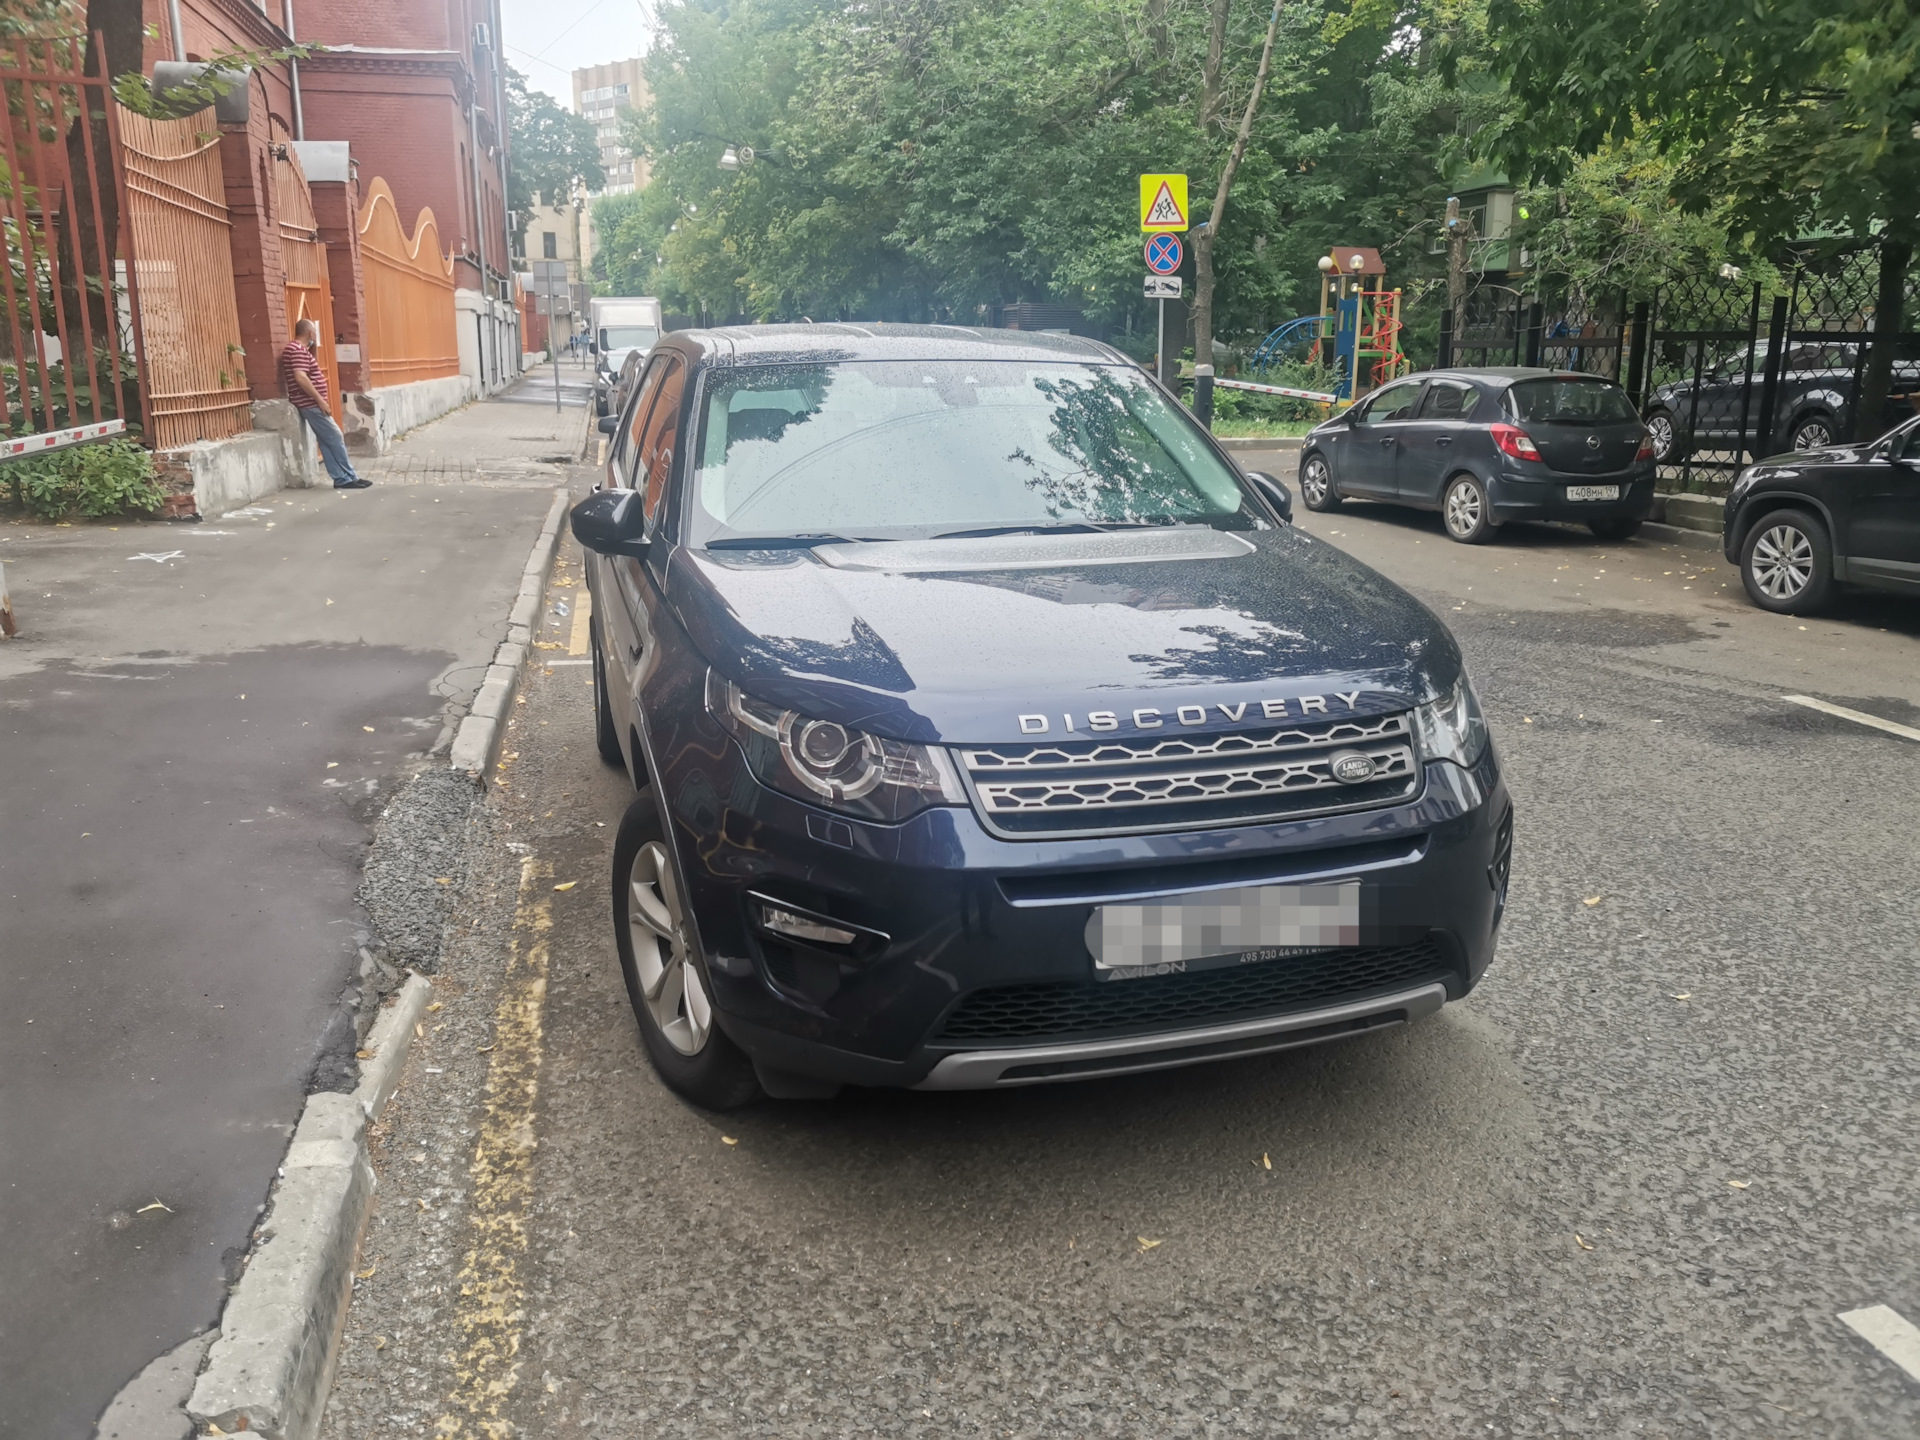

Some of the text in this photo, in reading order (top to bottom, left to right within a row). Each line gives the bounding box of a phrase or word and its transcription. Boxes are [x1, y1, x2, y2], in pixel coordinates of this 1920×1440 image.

[1018, 690, 1361, 734] DISCOVERY
[1343, 761, 1363, 771] LAND
[1346, 767, 1370, 778] ROVER
[1240, 952, 1258, 963] 495
[1260, 949, 1277, 961] 730
[1107, 961, 1187, 980] AVILON
